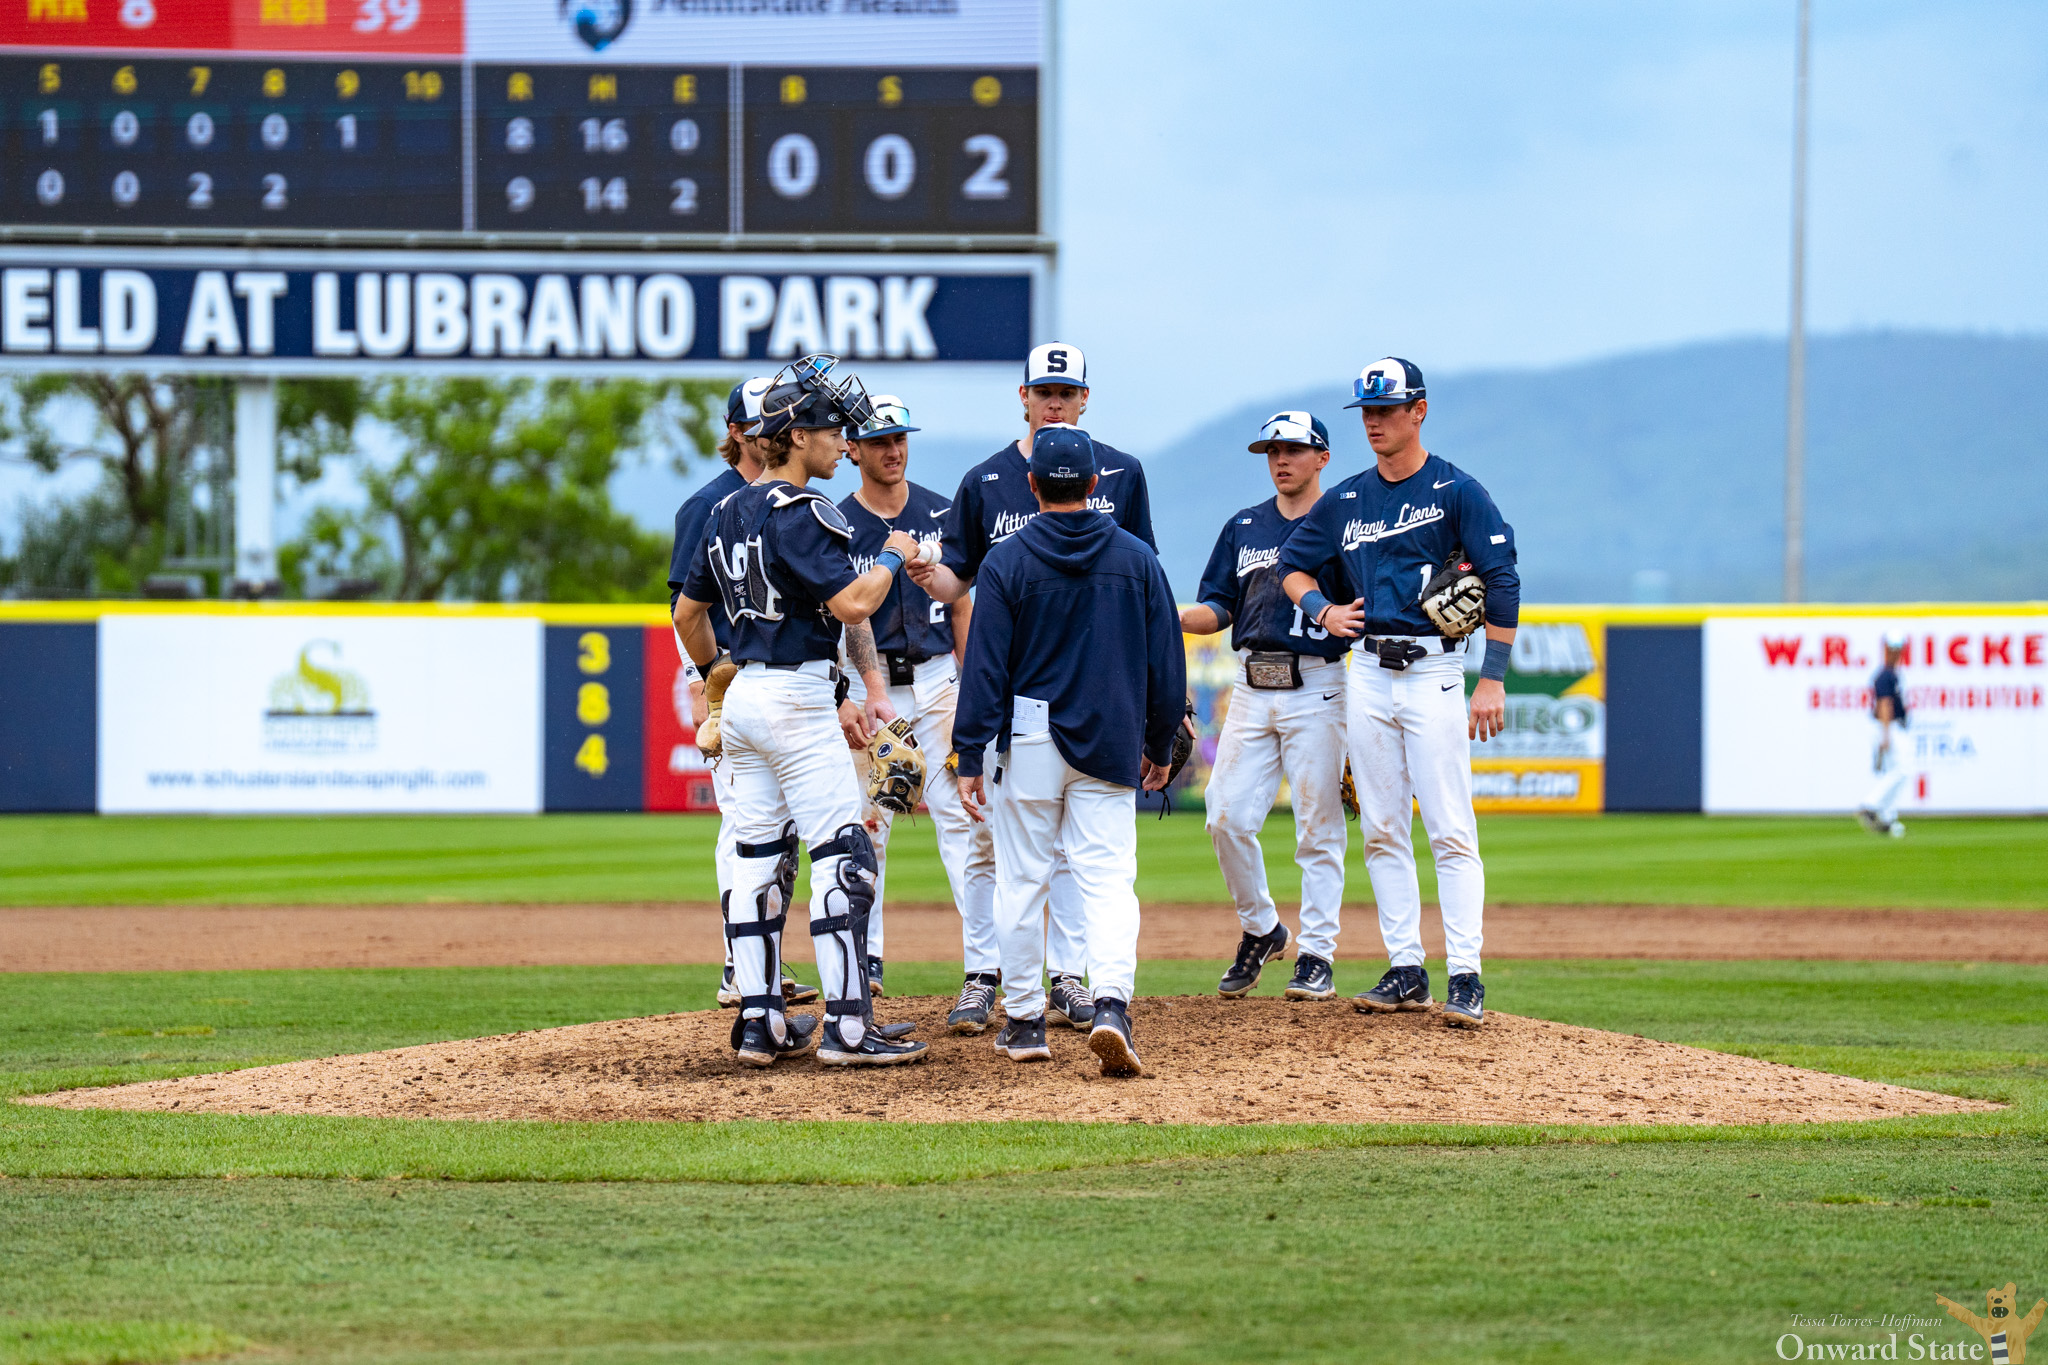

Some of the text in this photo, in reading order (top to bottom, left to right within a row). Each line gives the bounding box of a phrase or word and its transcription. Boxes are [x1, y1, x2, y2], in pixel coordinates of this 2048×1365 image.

[38, 63, 443, 100] 5 6 7 8 9 10
[672, 74, 698, 103] E
[878, 75, 903, 105] S
[37, 109, 358, 150] 1 0 0 0 1
[505, 117, 700, 155] 8 16 0
[767, 133, 1011, 199] 0 0 2
[36, 169, 289, 210] 0 0 2 2
[505, 176, 700, 214] 9 14 2
[2, 268, 940, 360] ELD AT LUBRANO PARK
[1047, 350, 1067, 373] S
[1394, 503, 1444, 528] Lions
[1761, 634, 1866, 667] W.R.
